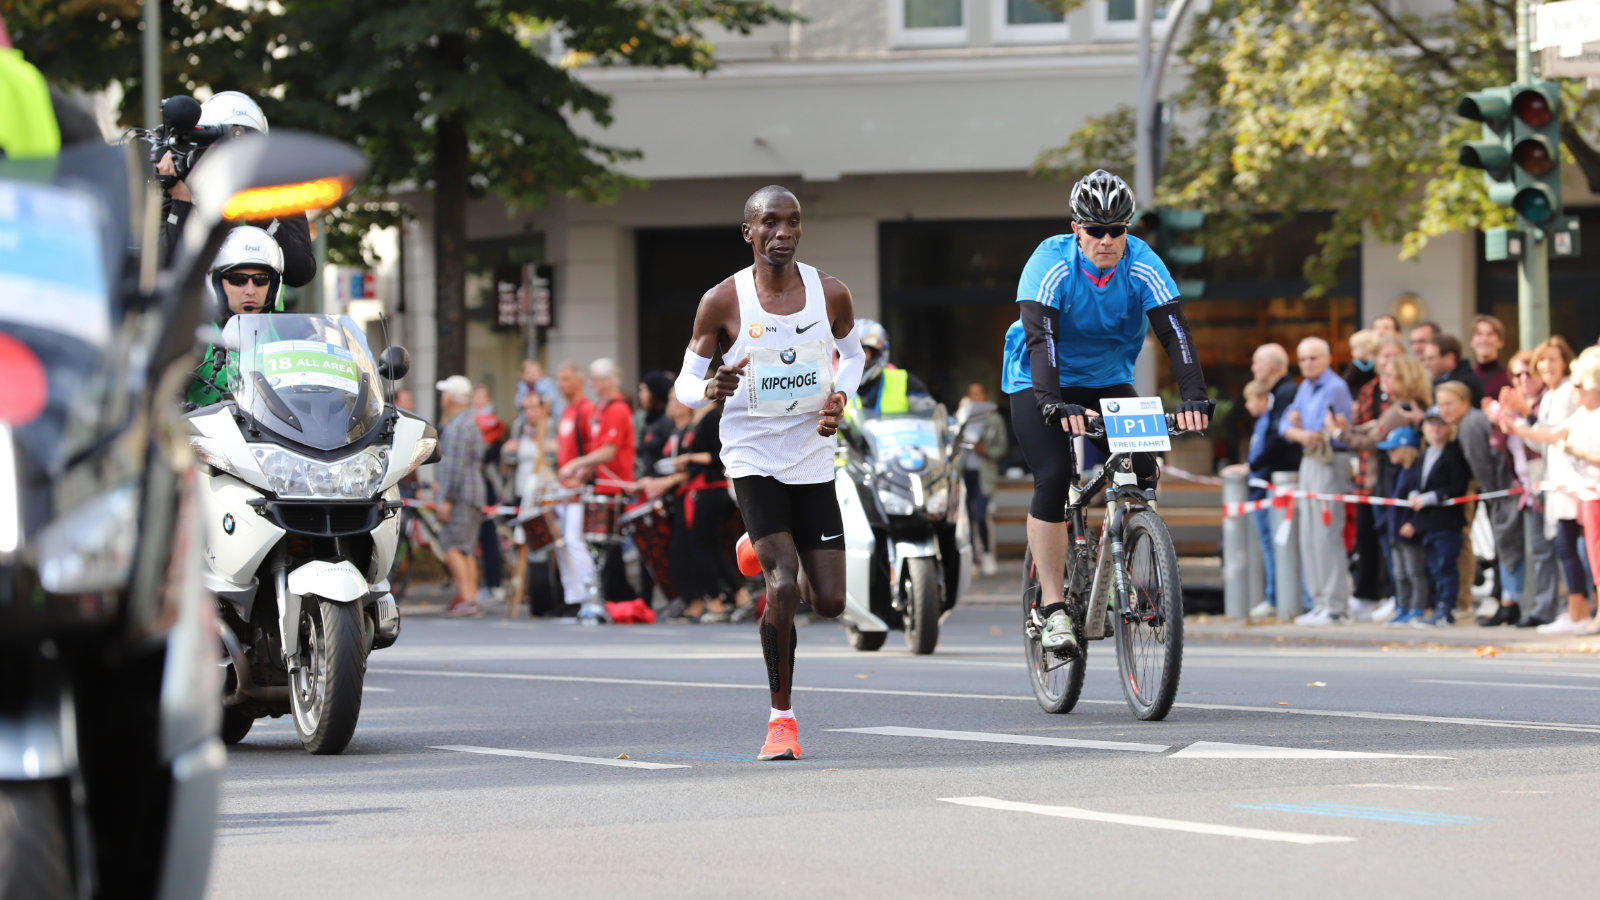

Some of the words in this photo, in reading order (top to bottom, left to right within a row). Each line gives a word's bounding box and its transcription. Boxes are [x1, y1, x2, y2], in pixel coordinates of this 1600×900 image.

[267, 357, 292, 371] 18
[296, 358, 320, 367] ALL
[322, 360, 354, 376] AREA
[761, 371, 817, 390] KIPCHOGE
[1123, 418, 1146, 434] P1
[1113, 440, 1137, 448] FREIE
